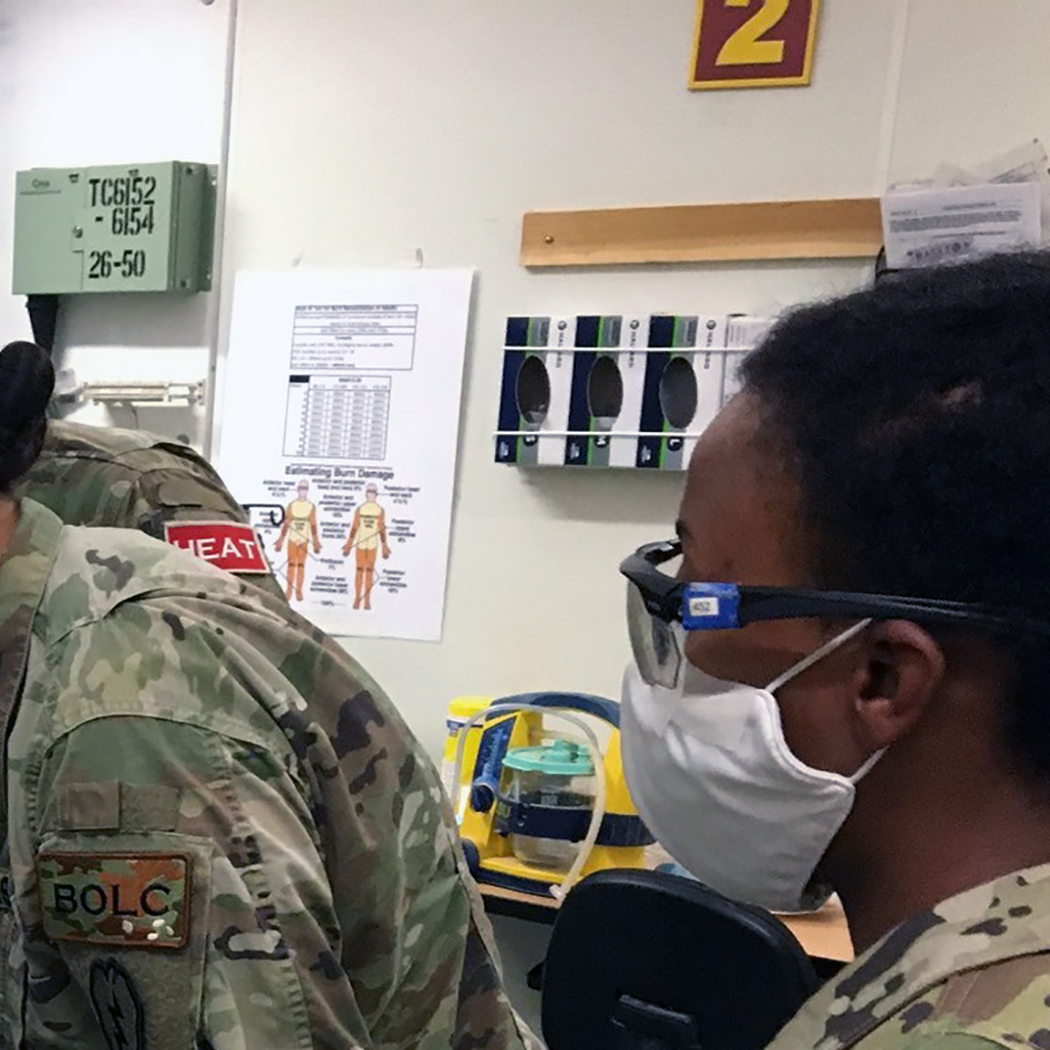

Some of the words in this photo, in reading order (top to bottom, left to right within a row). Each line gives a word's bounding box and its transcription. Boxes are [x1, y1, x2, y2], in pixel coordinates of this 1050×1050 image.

[715, 0, 789, 66] 2
[88, 177, 156, 207] TC6152
[111, 204, 154, 235] 6154
[88, 250, 146, 278] 26-50
[285, 466, 331, 478] Estimating
[334, 467, 356, 477] Burn
[358, 469, 394, 481] Damage
[53, 882, 171, 917] BOLC
